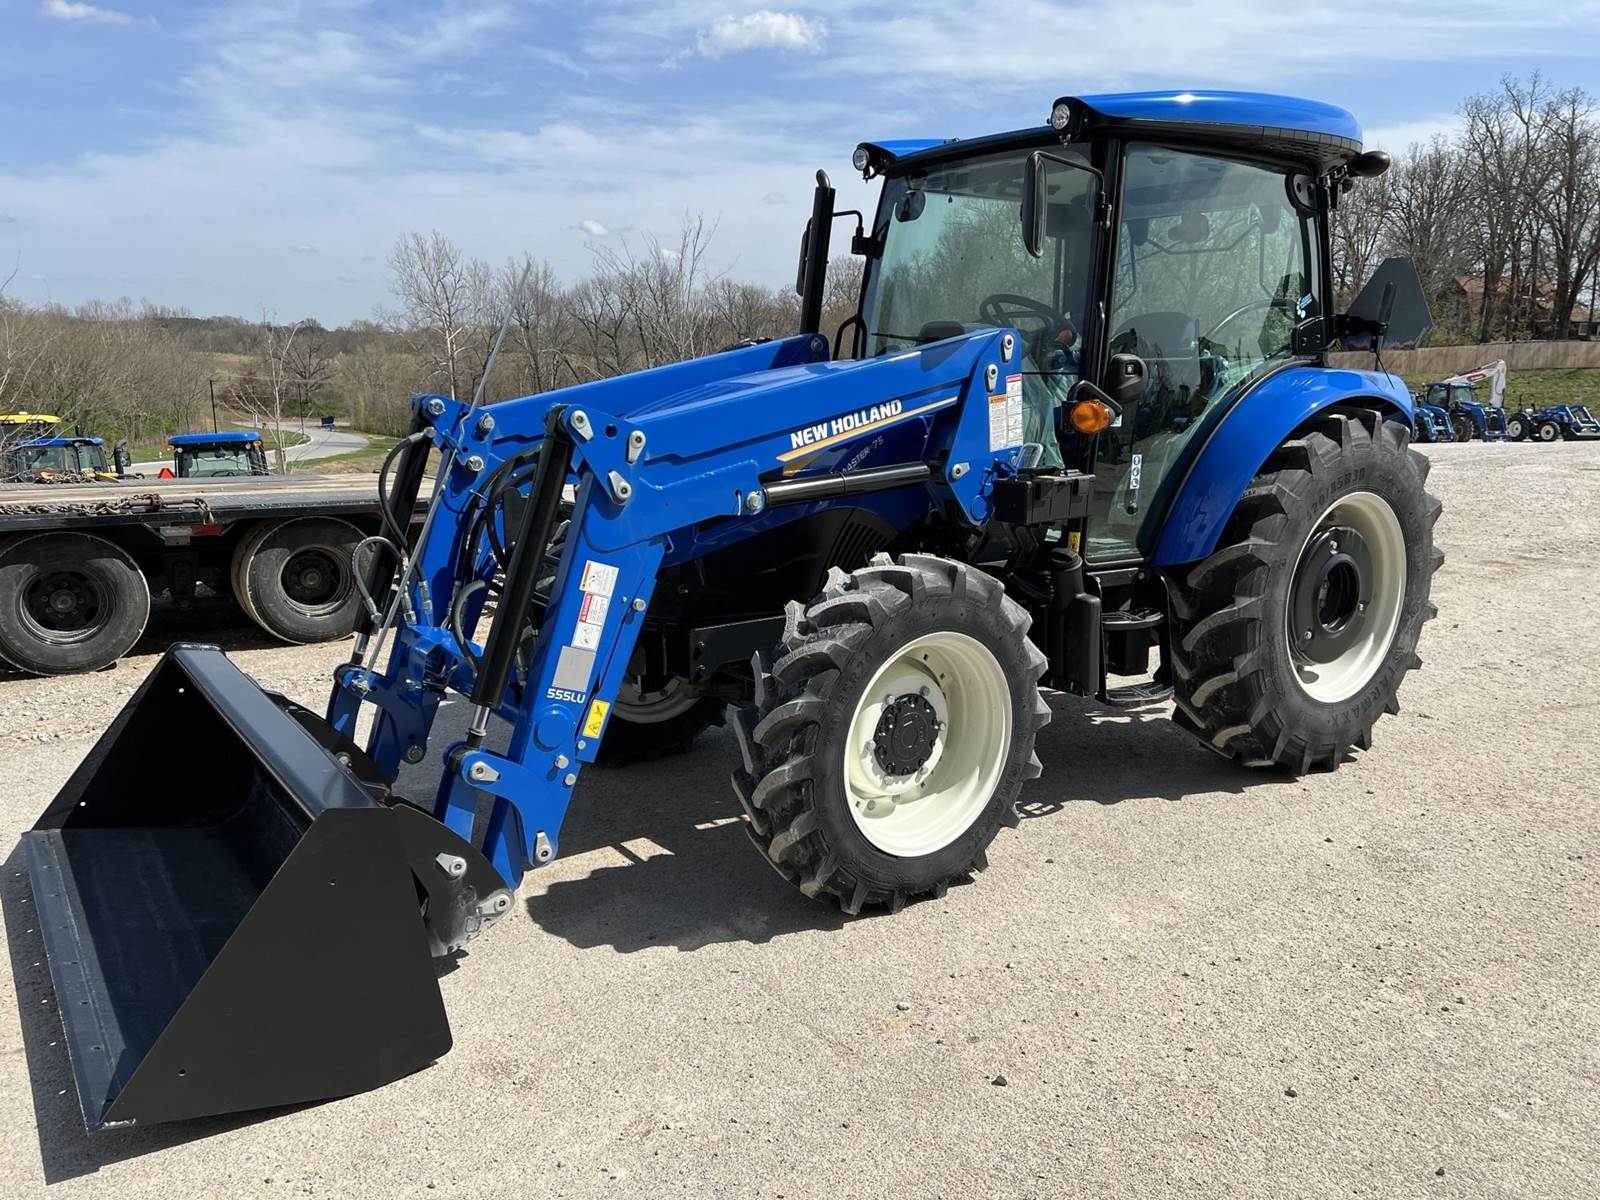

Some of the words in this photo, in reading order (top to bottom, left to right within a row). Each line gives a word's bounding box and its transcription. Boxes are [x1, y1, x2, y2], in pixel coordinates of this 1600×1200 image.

[790, 421, 829, 449] NEW
[831, 399, 903, 435] HOLLAND
[546, 687, 586, 704] 555LU
